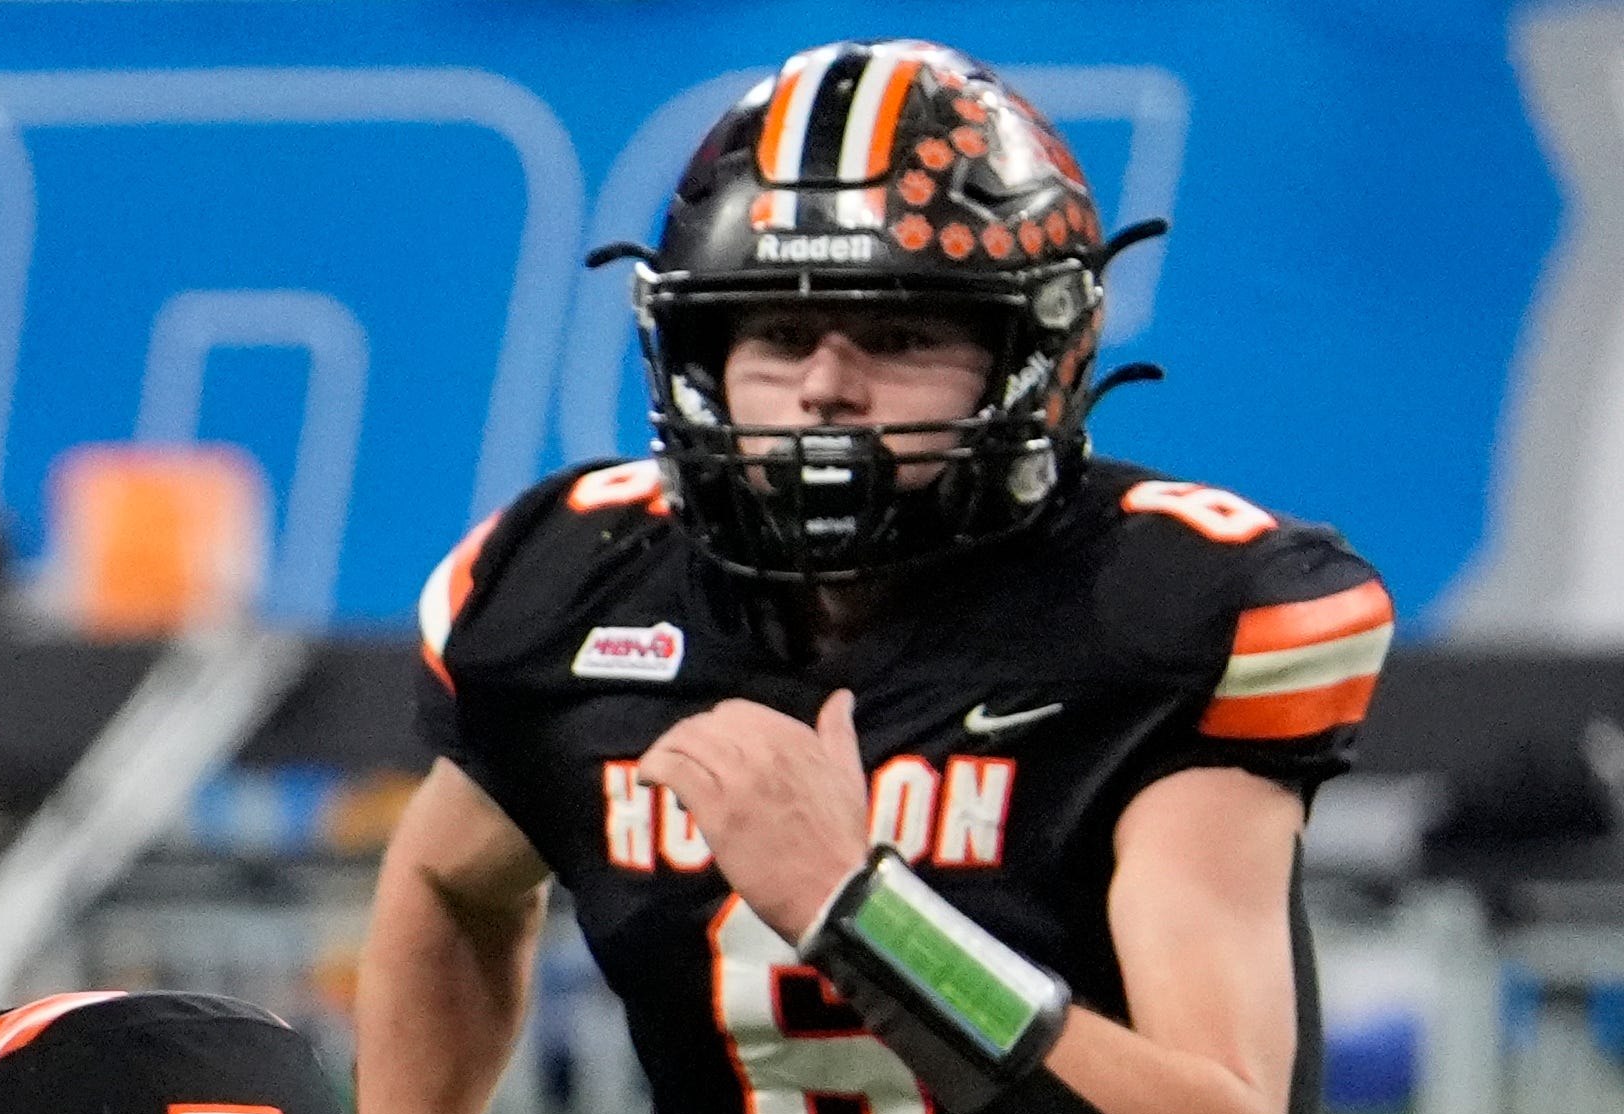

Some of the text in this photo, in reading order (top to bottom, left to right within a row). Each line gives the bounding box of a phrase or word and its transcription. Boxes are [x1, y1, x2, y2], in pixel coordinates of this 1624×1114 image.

[756, 233, 873, 263] Riddell
[1119, 479, 1280, 544] 6
[604, 753, 1017, 873] HUON
